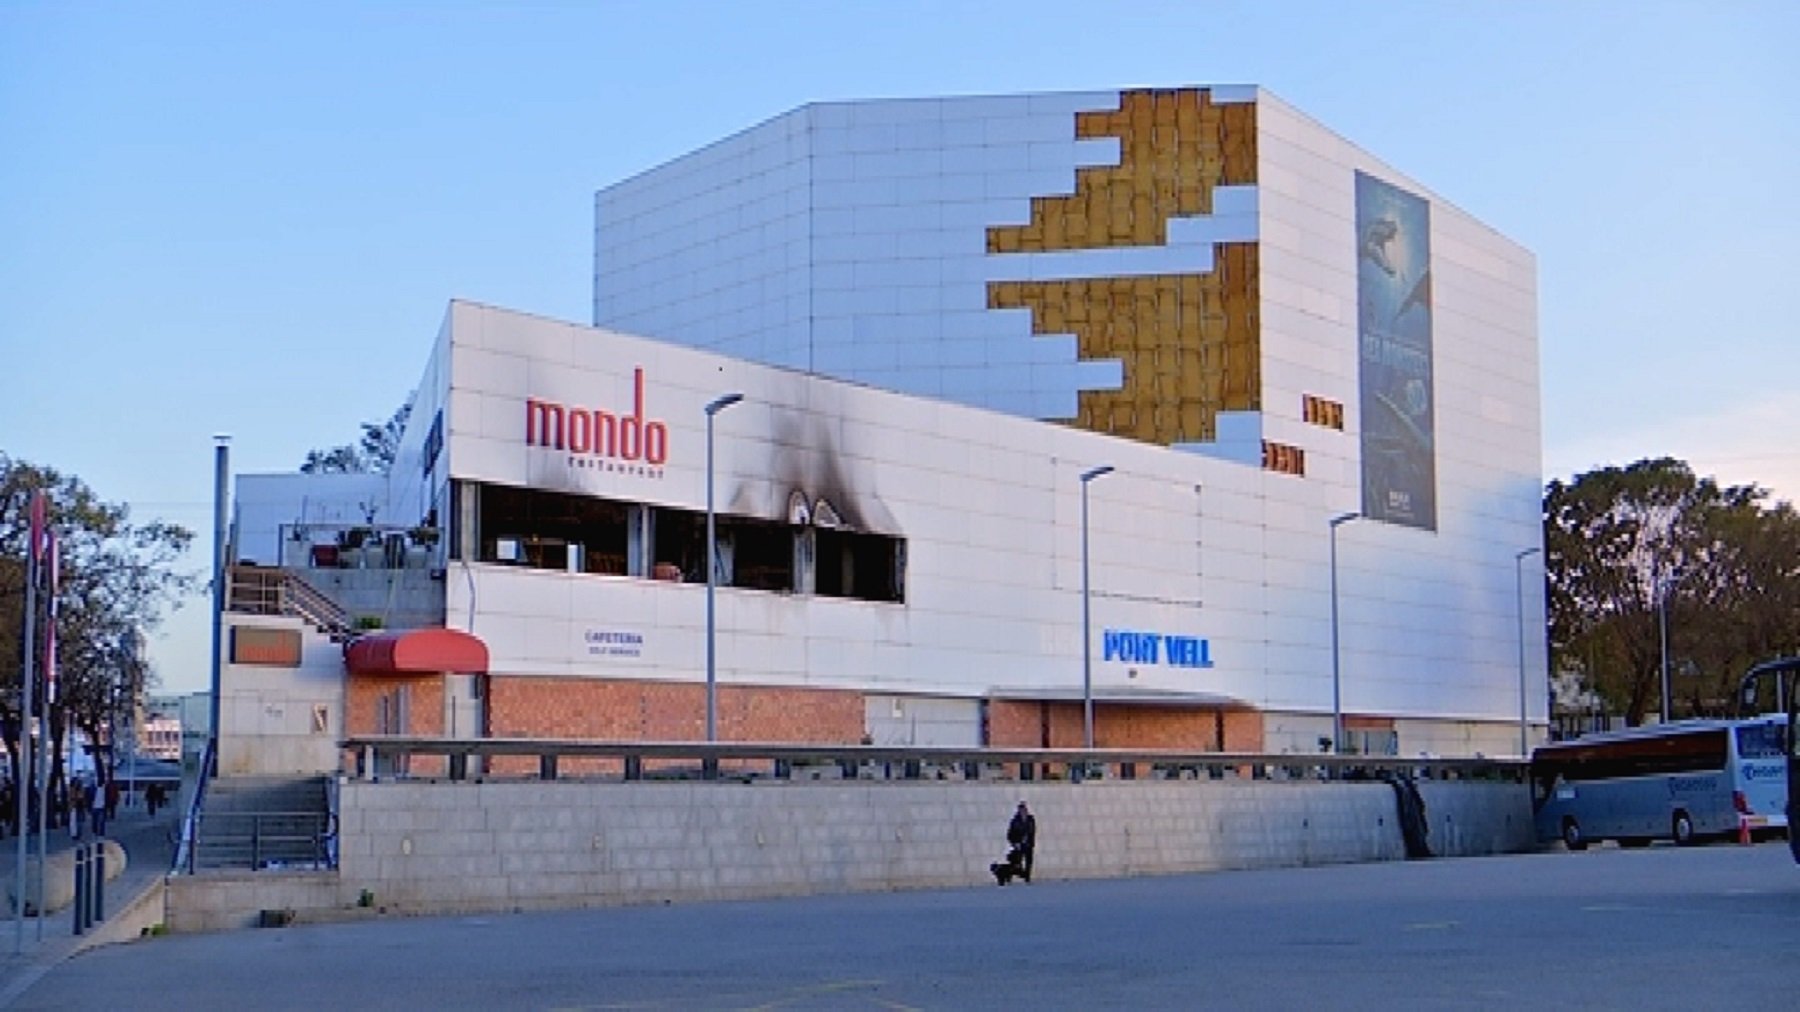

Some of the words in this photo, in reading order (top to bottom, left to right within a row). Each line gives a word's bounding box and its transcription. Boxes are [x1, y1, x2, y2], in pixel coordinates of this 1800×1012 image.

[526, 367, 666, 464] mondo
[584, 628, 643, 644] CAFETERIA
[1103, 629, 1162, 665] PORT
[1163, 634, 1214, 669] VELL
